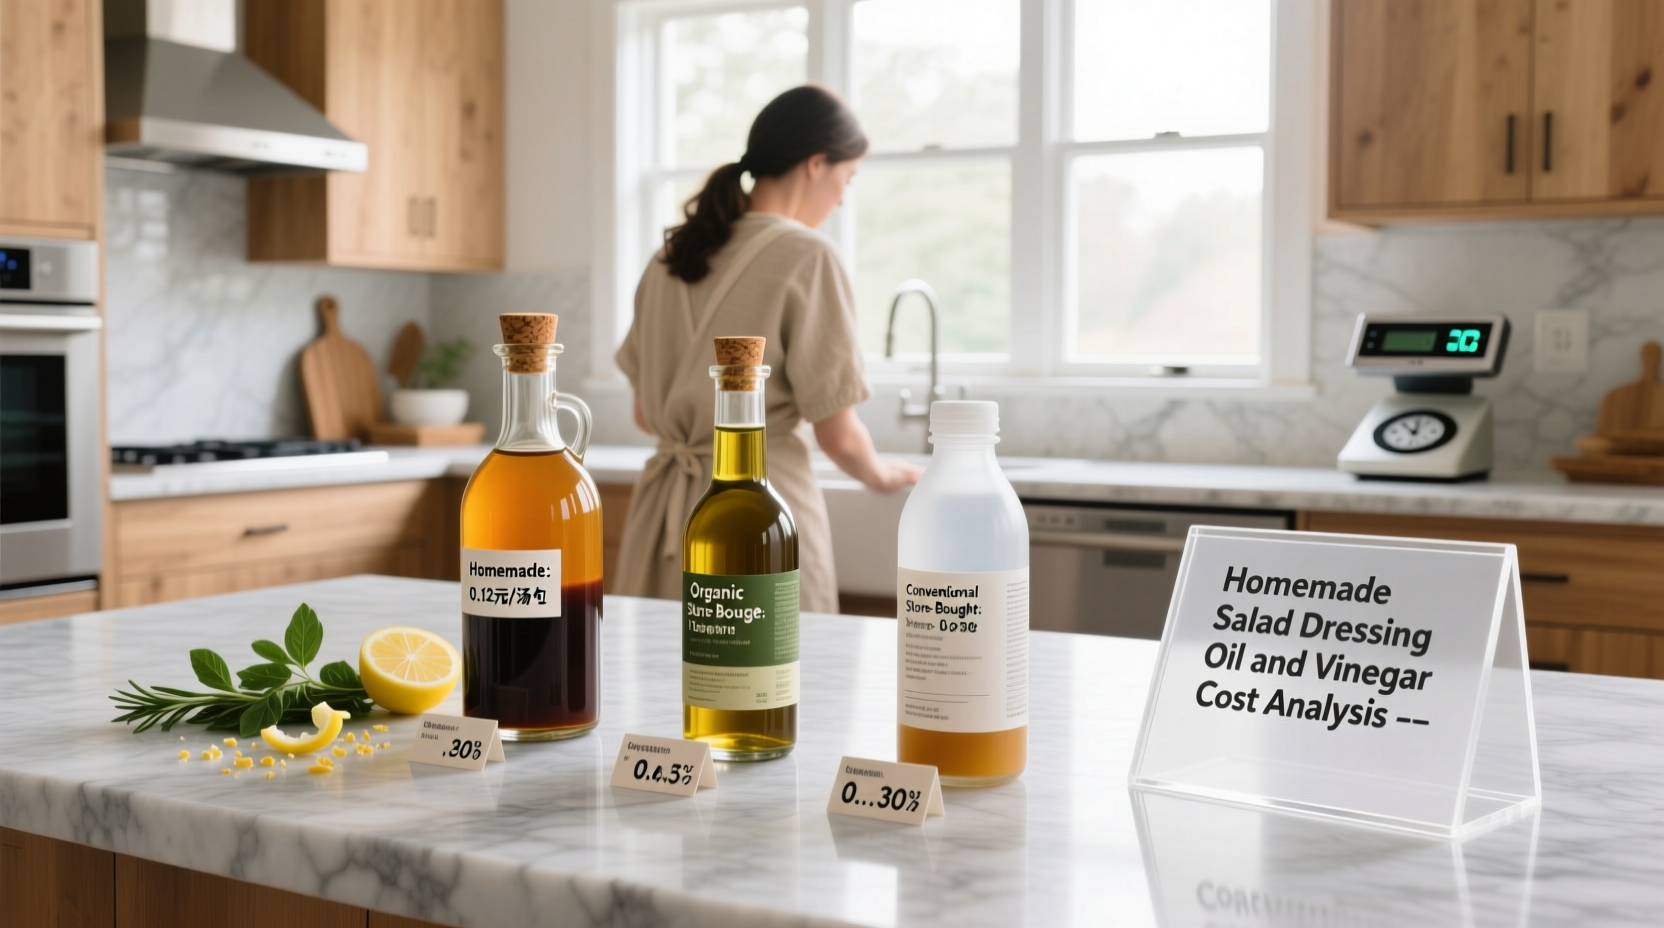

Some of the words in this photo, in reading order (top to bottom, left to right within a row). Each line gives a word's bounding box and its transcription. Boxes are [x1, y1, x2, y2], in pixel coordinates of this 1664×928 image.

[469, 561, 551, 578] Homemade:
[690, 581, 744, 604] Organic
[1222, 565, 1392, 605] Homemade
[1212, 603, 1295, 637] Salad
[1299, 611, 1433, 658] Dressing
[1204, 641, 1247, 671] Oil
[1250, 649, 1308, 678] and
[1315, 652, 1433, 696] Vinegar
[1195, 679, 1260, 713] Cost
[1262, 688, 1389, 731] Analysis
